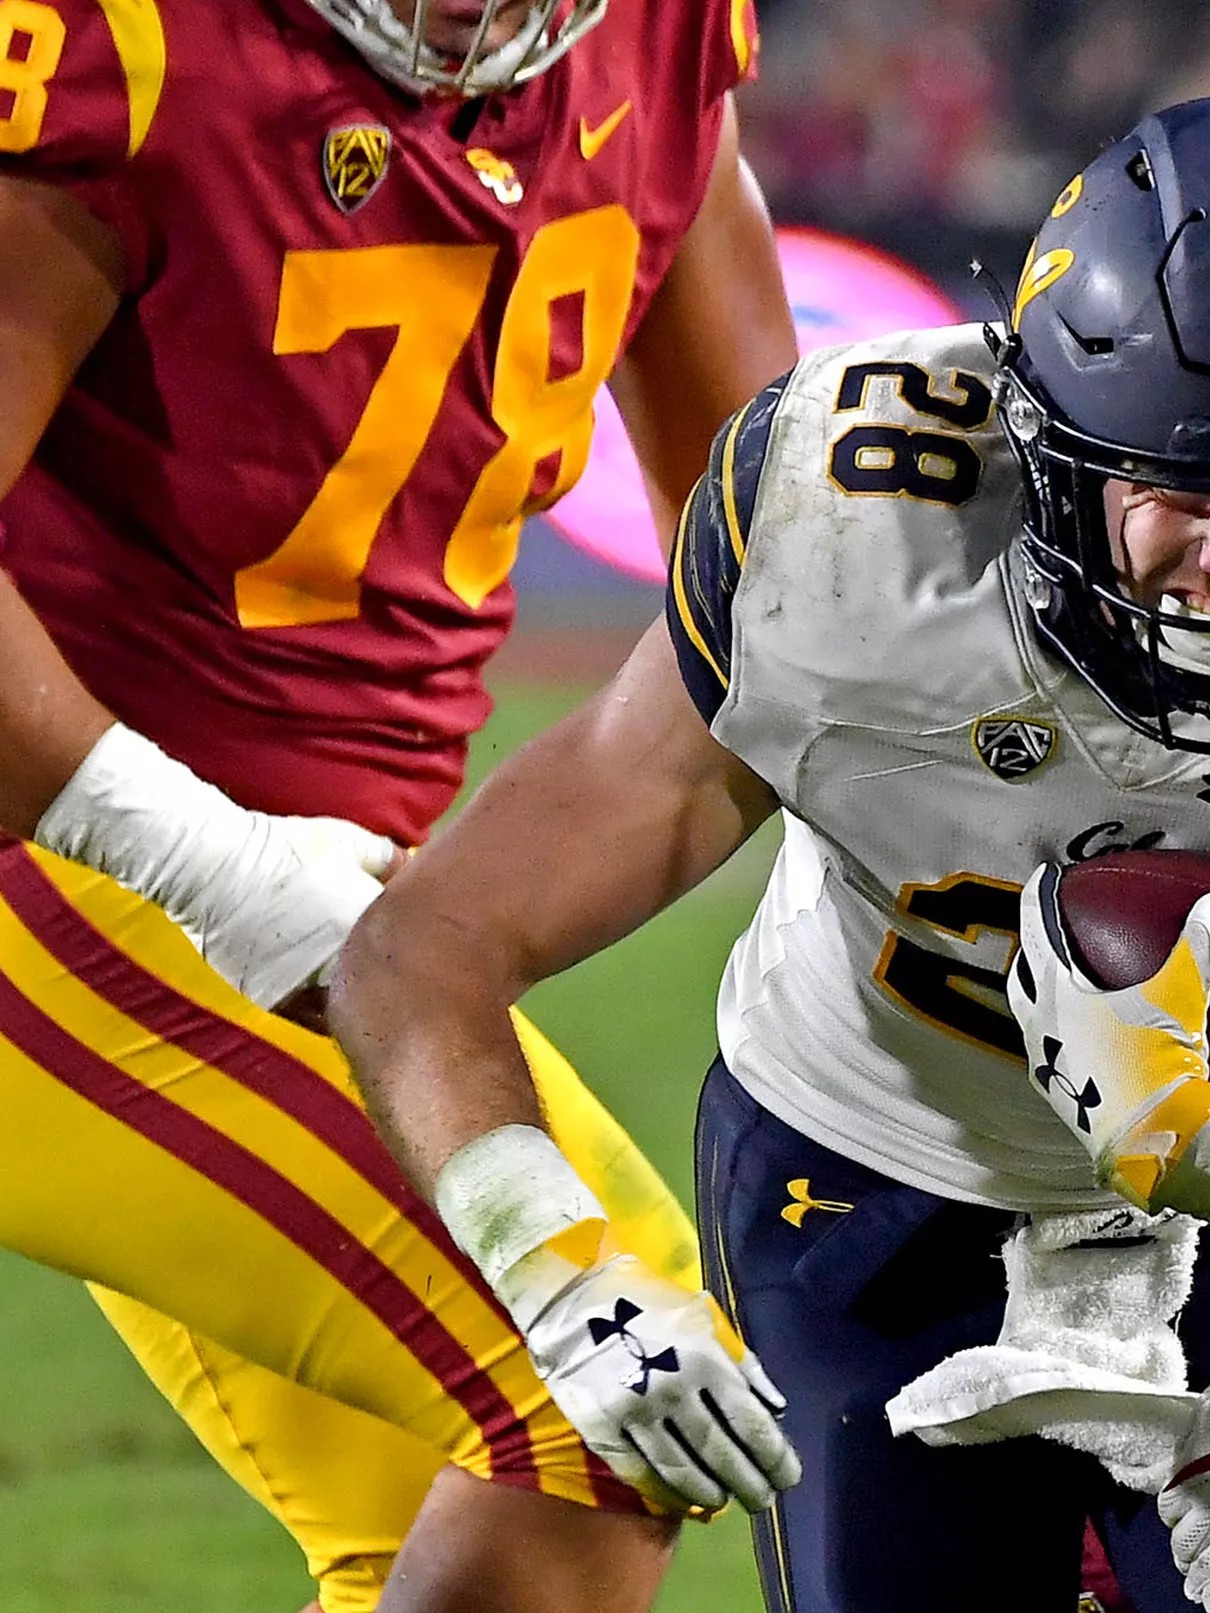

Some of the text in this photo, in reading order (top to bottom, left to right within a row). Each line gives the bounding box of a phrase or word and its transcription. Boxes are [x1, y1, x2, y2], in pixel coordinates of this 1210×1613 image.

[0, 0, 67, 154] 8
[338, 163, 370, 198] 12
[234, 205, 641, 629] 78
[825, 358, 997, 510] 28
[977, 721, 1051, 763] PAC
[989, 747, 1029, 772] 12
